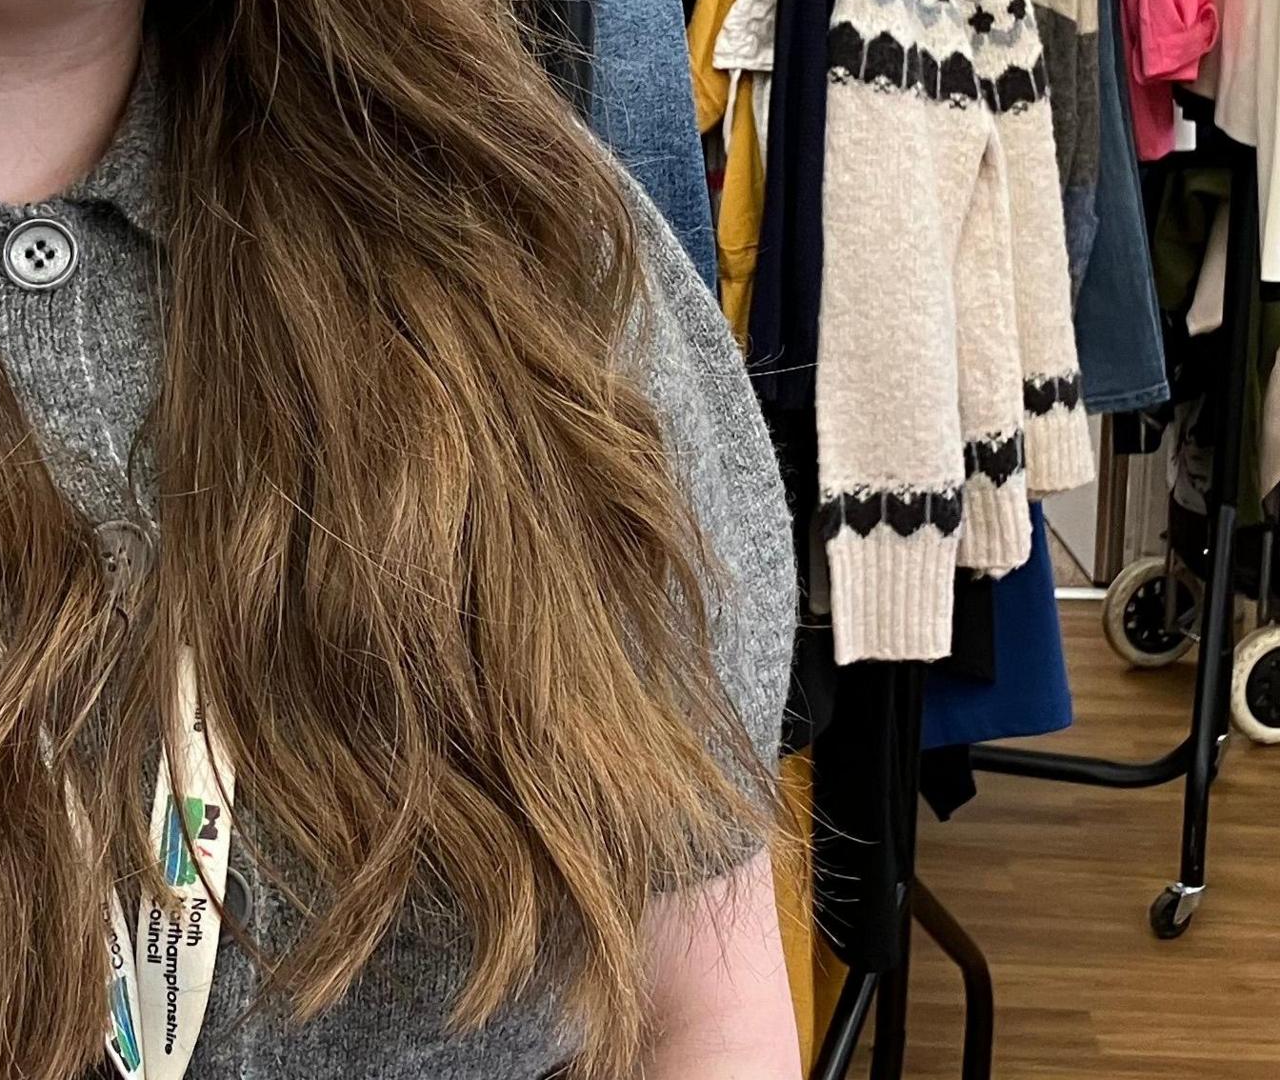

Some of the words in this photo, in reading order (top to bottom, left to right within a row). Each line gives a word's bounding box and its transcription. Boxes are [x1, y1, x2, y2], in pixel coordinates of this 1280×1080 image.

[147, 898, 163, 964] ouncil
[186, 898, 207, 946] North
[164, 896, 187, 1055] orthamptonshire
